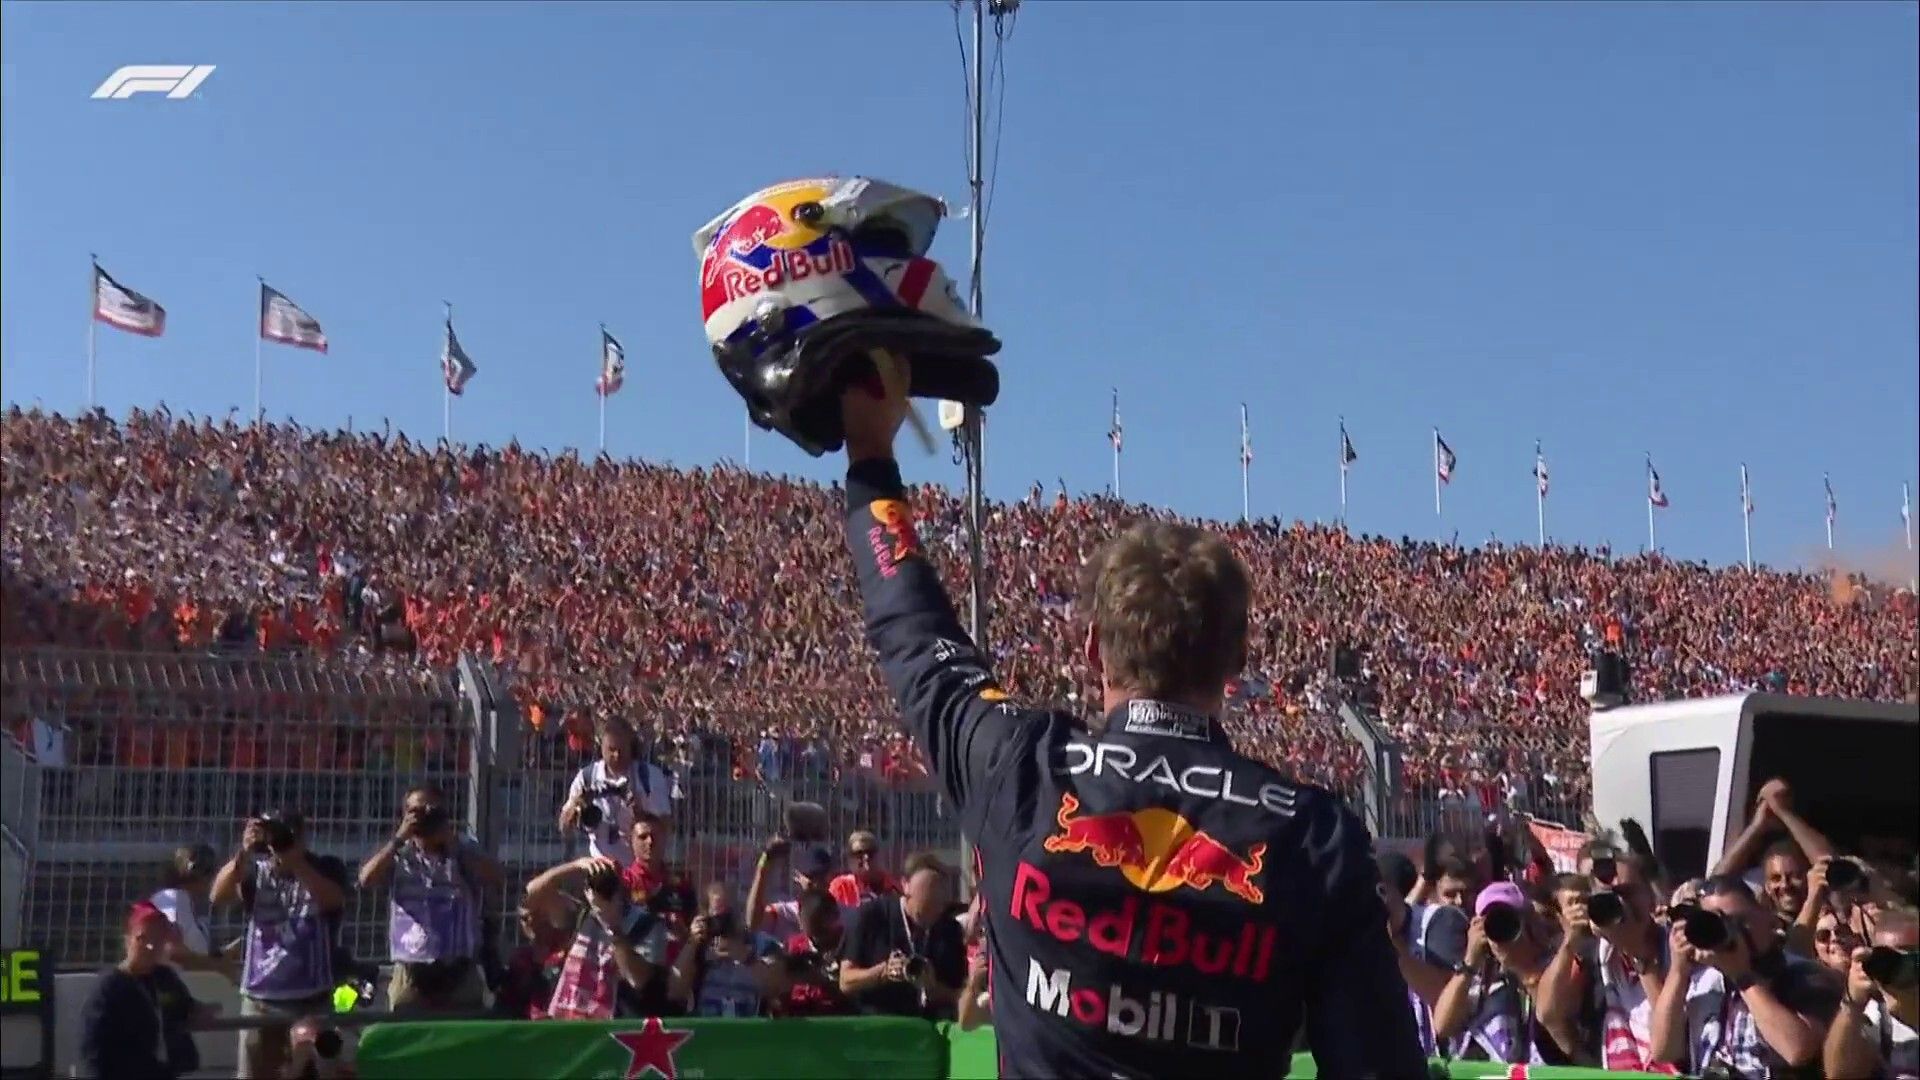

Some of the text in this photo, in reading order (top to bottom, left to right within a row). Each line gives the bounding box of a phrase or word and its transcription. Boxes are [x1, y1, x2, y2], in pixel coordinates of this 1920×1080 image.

[724, 240, 856, 302] Red Bull
[1009, 860, 1277, 983] Red Bull
[1025, 955, 1177, 1042] Mobil
